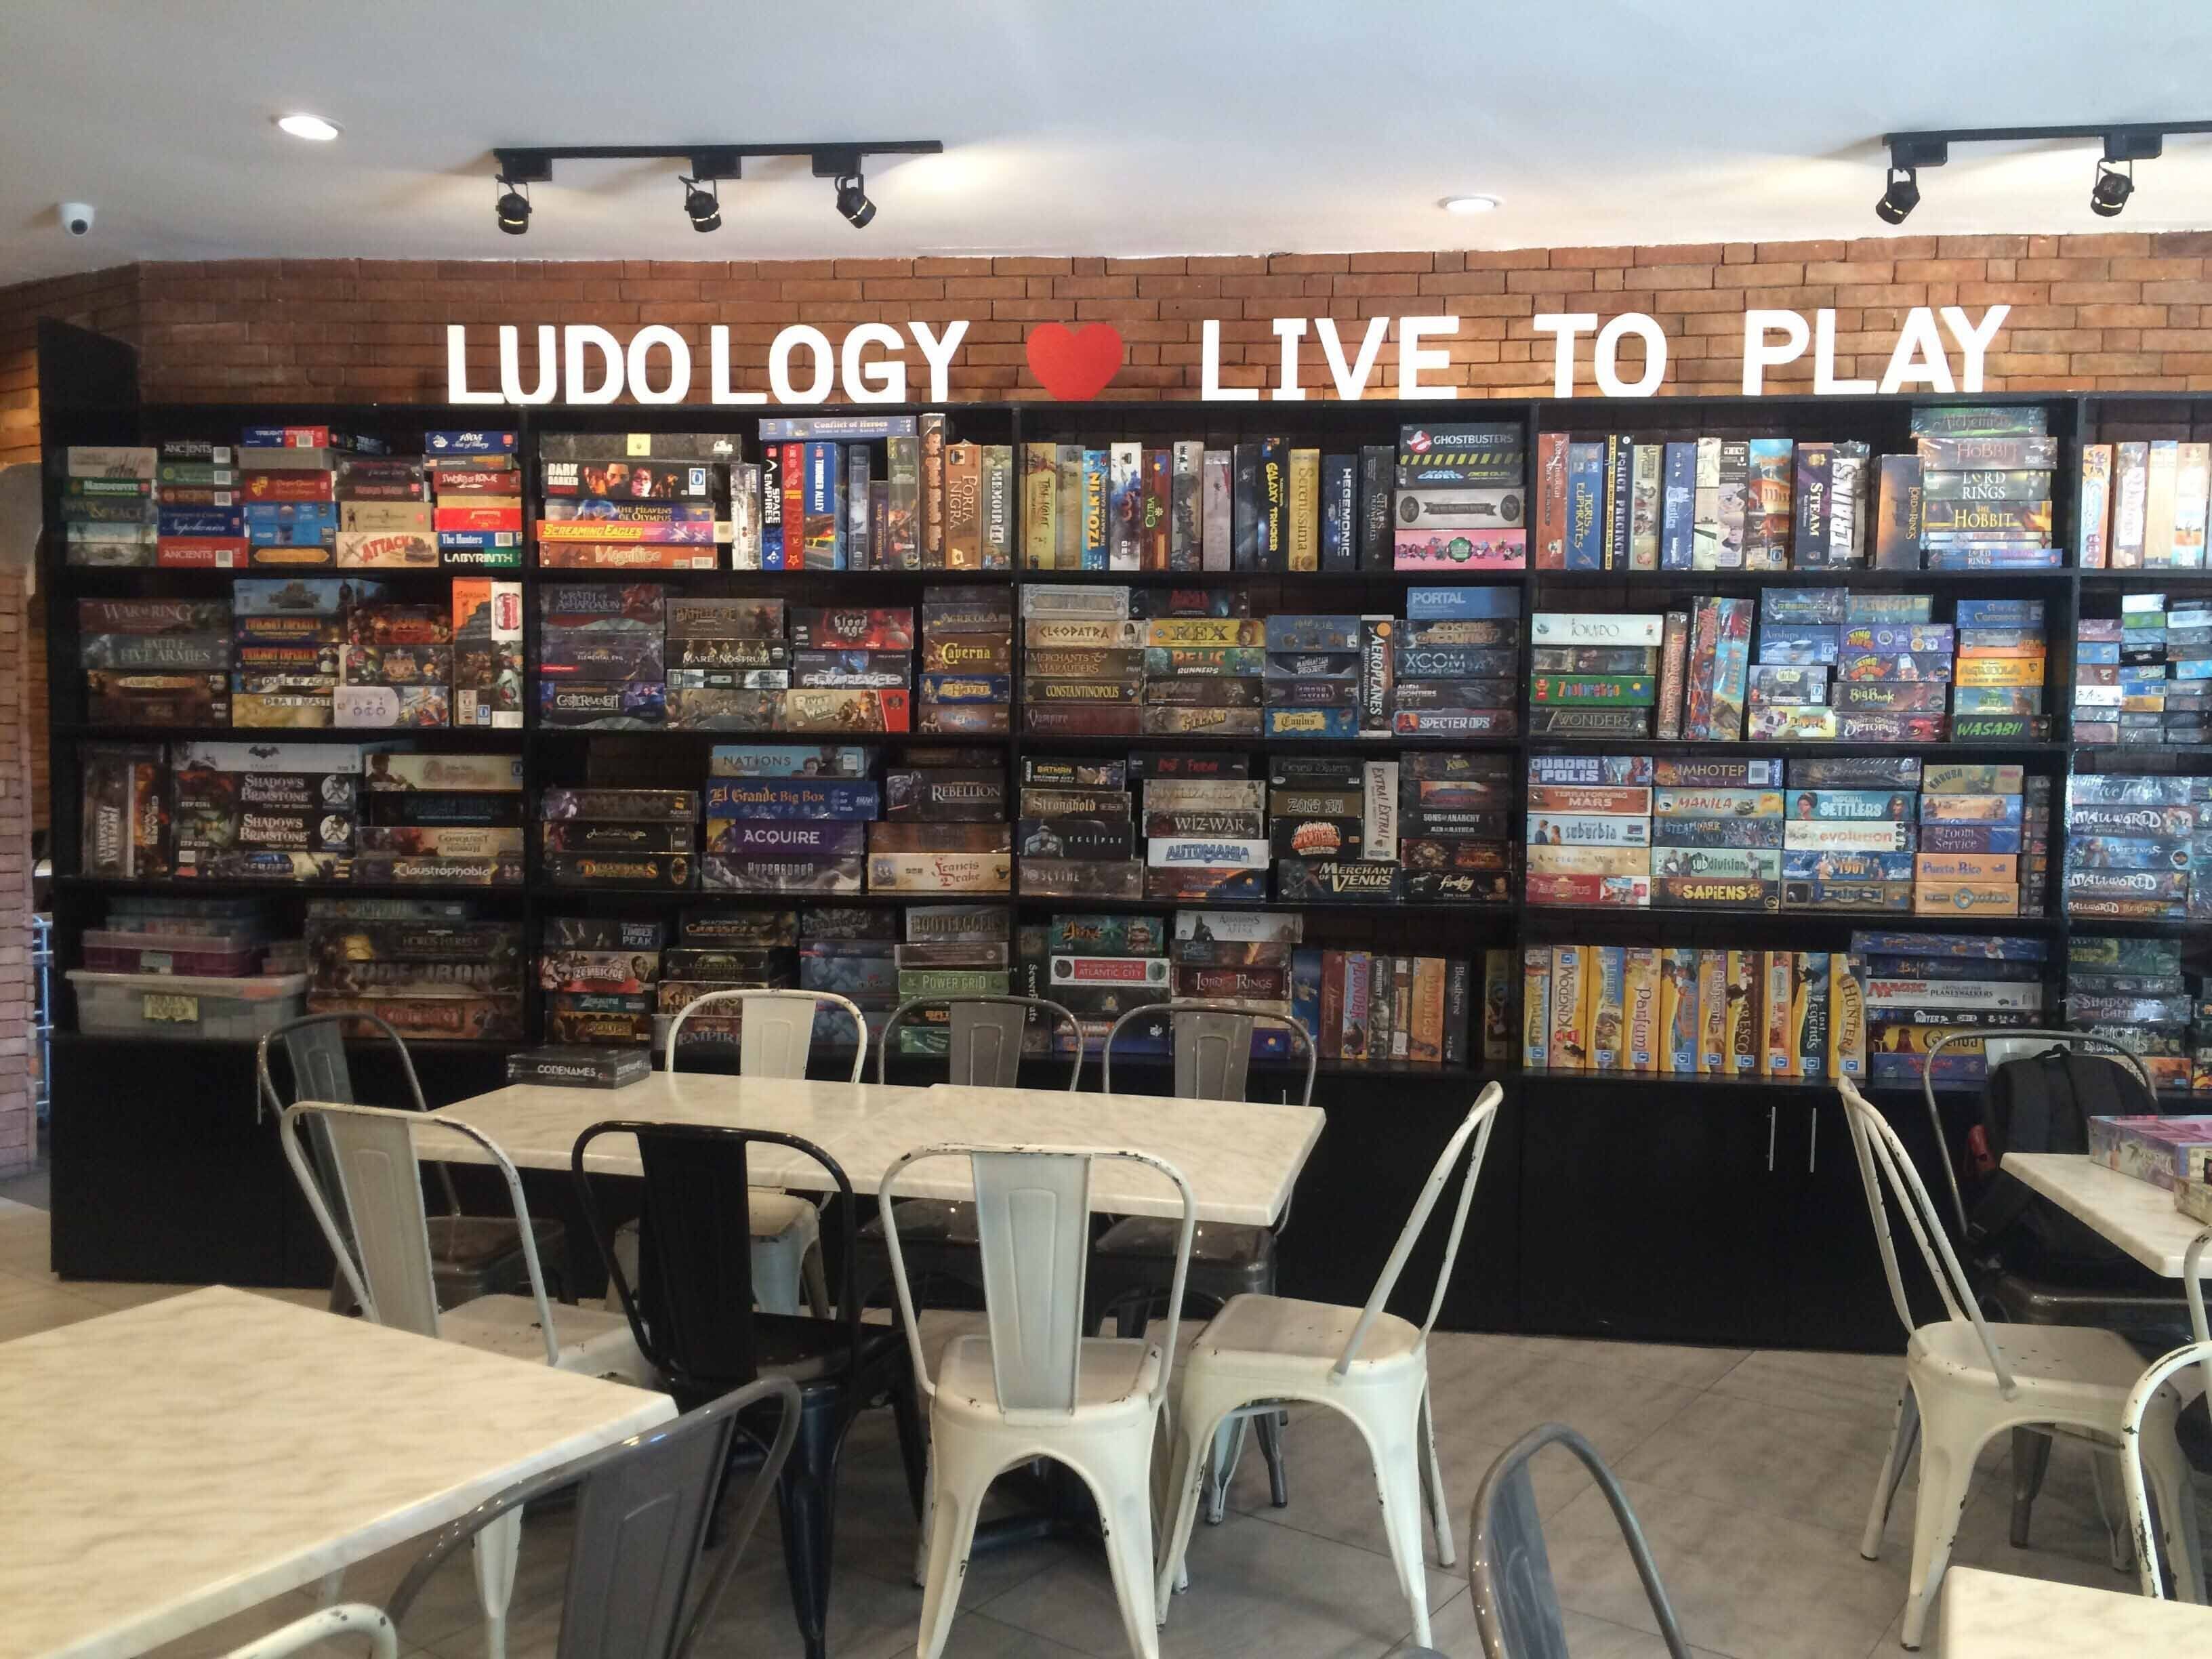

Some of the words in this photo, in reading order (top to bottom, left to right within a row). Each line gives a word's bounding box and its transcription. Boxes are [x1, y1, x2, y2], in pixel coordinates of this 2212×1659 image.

[1202, 316, 1460, 401] LIVE
[1533, 312, 1666, 398] TO
[1743, 305, 2011, 396] PLAY
[1433, 434, 1513, 445] GHOSTBUSTERS
[164, 445, 211, 453] ANCIENTS
[548, 464, 578, 476] DARK
[1616, 451, 1626, 493] POLICE
[1265, 462, 1277, 504] GALAXY
[764, 474, 773, 524] EMPIRES
[962, 474, 977, 522] PORTA
[991, 470, 1004, 523] MEMOIR
[1908, 487, 1920, 506] LORD
[1963, 487, 2006, 499] RINGS
[815, 490, 824, 512] ALLEY
[949, 480, 961, 530] NIGRA
[1830, 464, 1857, 548] TRAINS
[1145, 496, 1155, 529] CUBA
[1298, 466, 1313, 551] Serenissima
[1340, 468, 1352, 557] HEGEMONIC
[1576, 482, 1585, 548] EUPHRATES
[1584, 493, 1593, 527] TIGRIS
[1809, 483, 1822, 536] STEAM
[632, 513, 672, 522] OLYMPUS
[1954, 510, 2013, 528] HOBBIT
[542, 524, 604, 537] SCREAMING
[605, 524, 644, 537] EAGLES
[1269, 506, 1277, 551] TRUCKER
[1614, 499, 1626, 556] PRECINCT
[1906, 514, 1918, 539] RINGS
[442, 534, 455, 545] The
[456, 534, 483, 545] Hunters
[163, 550, 212, 559] ANCIENTS
[444, 553, 513, 563] LABYRINTH
[1412, 592, 1466, 605] PORTAL
[834, 616, 867, 627] blood
[941, 613, 998, 623] AGRICOLA
[838, 627, 863, 636] rage
[1040, 626, 1109, 639] CLEOPATRA
[1170, 626, 1229, 640] REX
[1766, 630, 1799, 642] Airships
[1850, 630, 1870, 639] KING
[157, 650, 211, 661] ARMIES
[683, 655, 713, 663] MARE
[718, 653, 770, 663] NOSTRUM
[942, 643, 991, 664] Caverna
[1030, 652, 1088, 663] MERCHANTS
[1405, 653, 1465, 668] XCOM
[1856, 656, 1878, 668] KING
[1177, 666, 1219, 674] RUNNERS
[1369, 634, 1385, 716] AEROPLANES
[264, 678, 290, 686] DUEL
[1046, 685, 1118, 699] CONSTANTINOPOLIS
[1558, 682, 1620, 698] Zooloretto
[1281, 716, 1315, 726] Caylus
[1419, 717, 1462, 729] SPECTER
[1469, 717, 1490, 729] OPS
[1558, 715, 1630, 727] WONDERS
[1844, 723, 1899, 737] OCTOPUS
[723, 754, 791, 766] NATIONS
[1038, 766, 1072, 774] BATMAN
[1541, 770, 1599, 781] POLIS
[1679, 764, 1746, 776] IMHOTEP
[245, 775, 304, 788] SHADOWS
[1929, 768, 1964, 789] KARUBA
[932, 785, 1002, 801] REBELLION
[1372, 767, 1390, 805] EXTRA!
[241, 788, 311, 802] BRIMSTONE
[711, 788, 728, 807] El
[732, 786, 777, 802] Grande
[780, 791, 798, 804] Big
[803, 789, 825, 802] Box
[1568, 797, 1612, 807] MARS
[1032, 796, 1096, 813] Stronghold
[1288, 798, 1319, 813] ZONG
[1677, 798, 1732, 808] MANILA
[1820, 802, 1882, 817] SETTLERS
[244, 815, 303, 828] SHADOWS
[1175, 817, 1244, 831] WIZ-WAR
[1377, 805, 1390, 839] EXTRA!
[1448, 815, 1479, 823] ANARCHY
[102, 806, 120, 863] IMPERIAL
[240, 827, 311, 842] BRIMSTONE
[744, 830, 820, 844] ACQUIRE
[1565, 822, 1616, 840] suburbia
[1820, 830, 1892, 843] evolution
[1069, 834, 1122, 846] ECLIPSE
[1936, 838, 1978, 849] Service
[1166, 844, 1250, 863] AUTOMANIA
[1319, 862, 1393, 876] MERCHANT
[1923, 862, 1954, 873] Puerto
[1959, 862, 1981, 874] Rico
[940, 872, 980, 886] Drake
[1041, 870, 1079, 882] SCYTHE
[1332, 874, 1391, 892] VENUS
[1438, 876, 1475, 892] firefly
[623, 936, 651, 945] PEAK
[573, 966, 626, 981] ZOMBICIDE
[1079, 968, 1118, 976] ATLANTIC
[1123, 968, 1142, 976] CITY
[923, 975, 958, 988] POWER
[962, 975, 986, 988] GRID
[1195, 972, 1222, 989] LORD
[1235, 974, 1272, 989] RINGS
[1028, 964, 1038, 1022] SewerPats
[1353, 960, 1367, 1019] PLUNDER
[1866, 982, 1927, 998] MAGIC
[1930, 989, 1993, 998] PLANESWALKERS
[1558, 966, 1573, 1028] KINGDOM
[1632, 987, 1652, 1049] Parfum
[1806, 994, 1826, 1049] Legends
[1843, 985, 1856, 1046] HUNTER
[537, 1065, 596, 1077] CODENAMES
